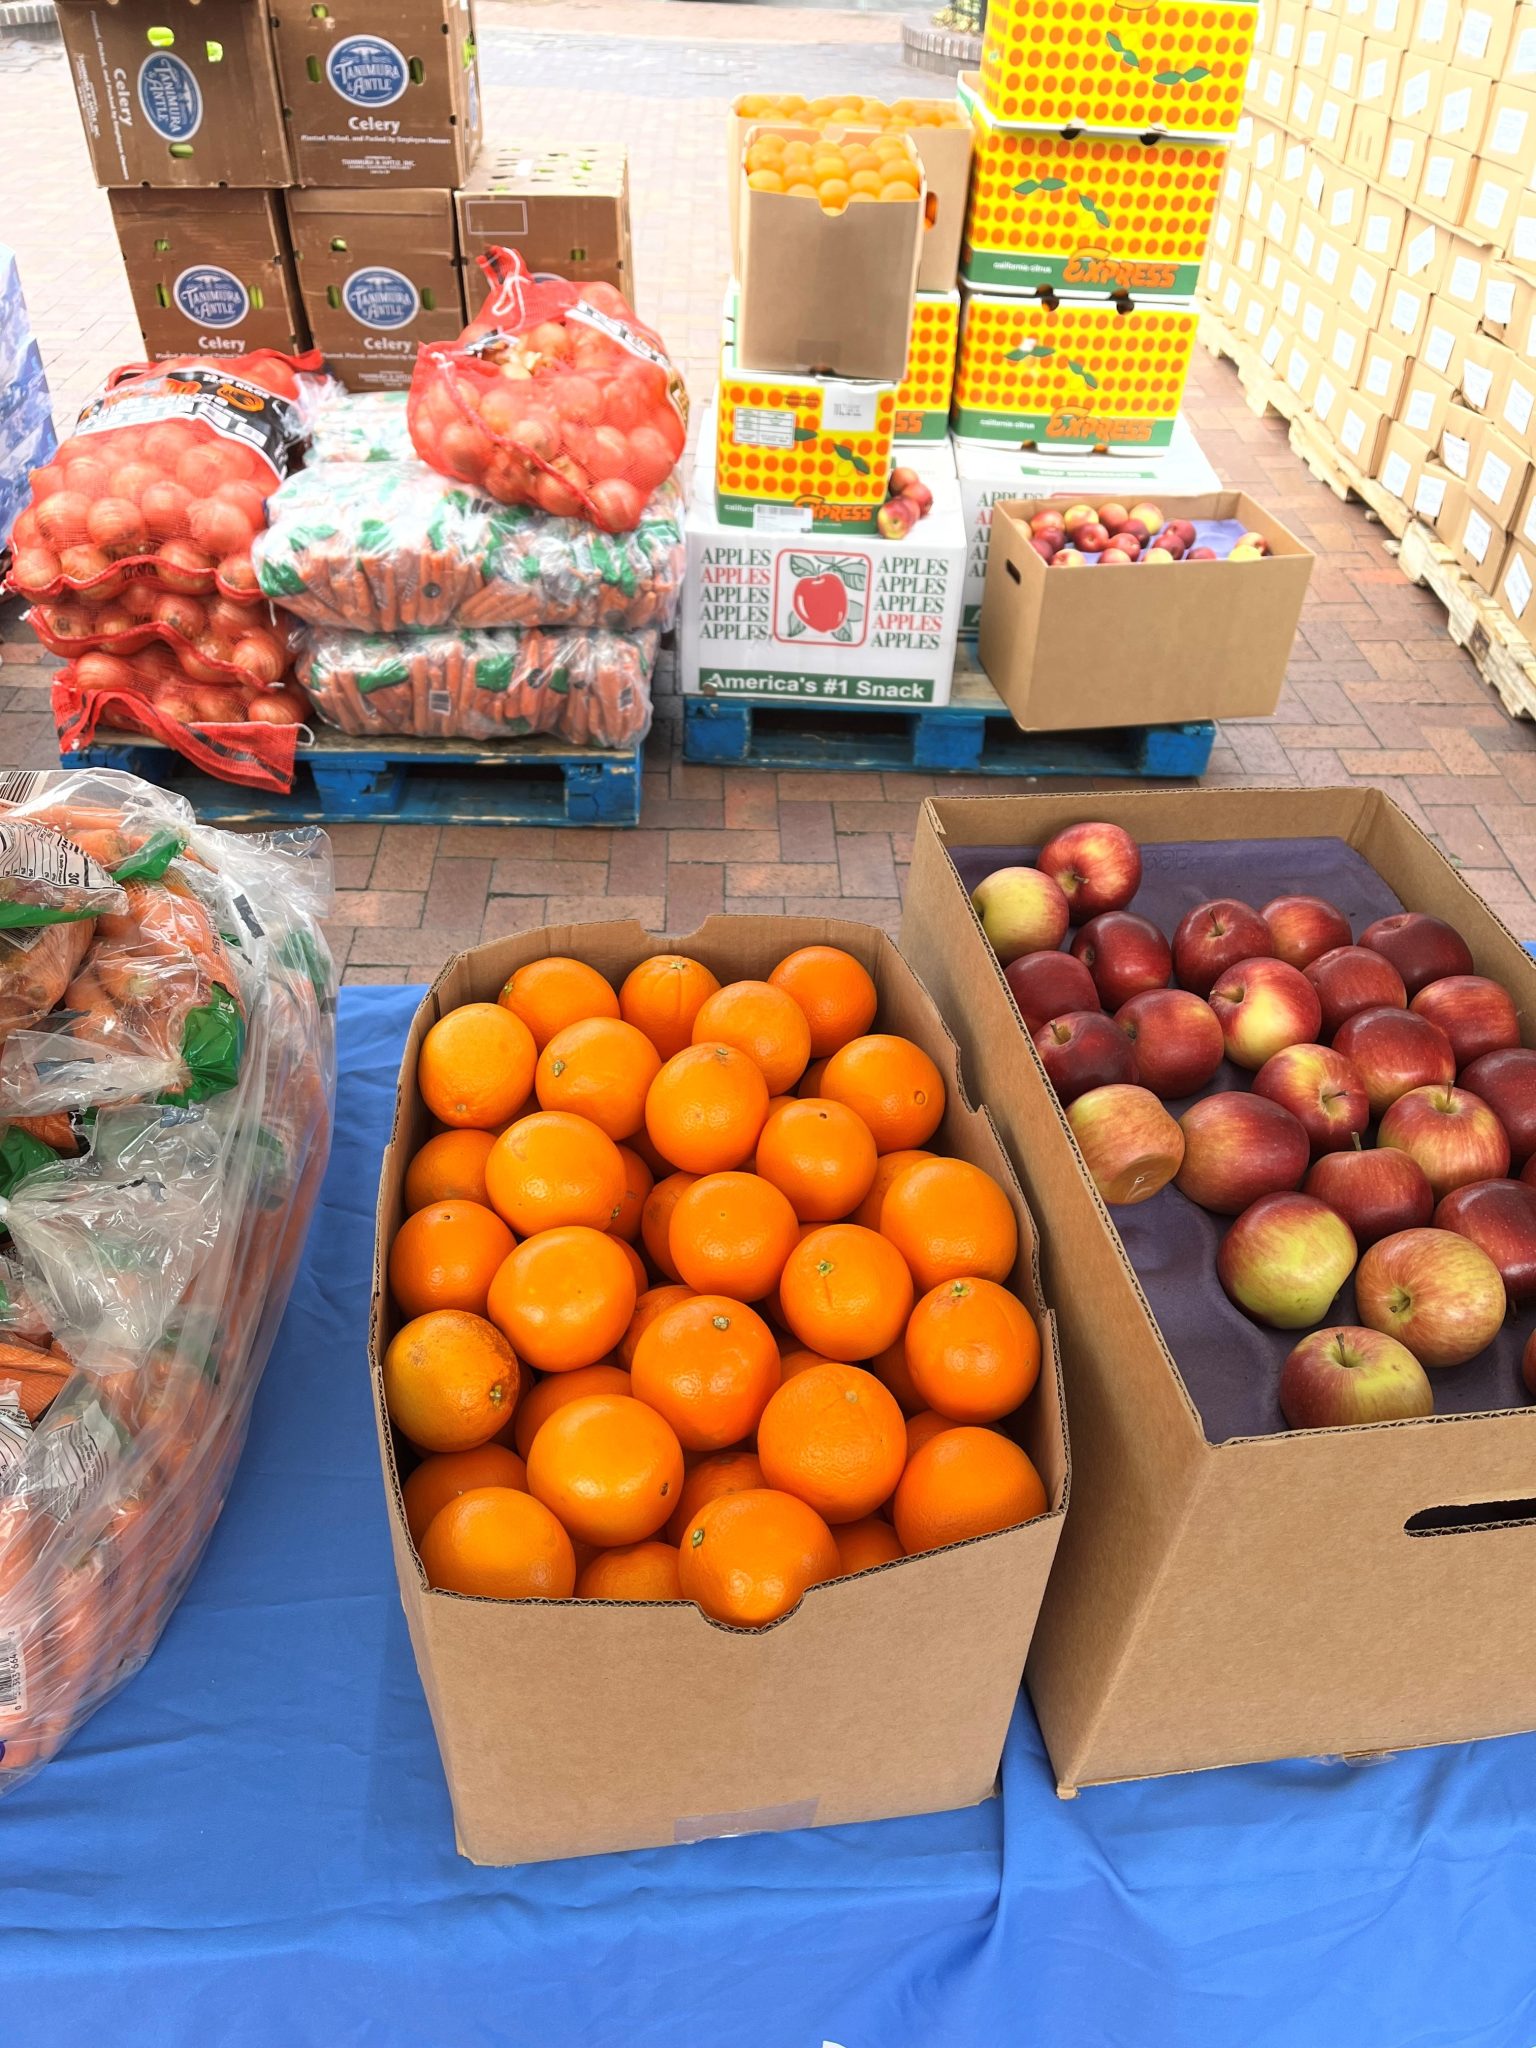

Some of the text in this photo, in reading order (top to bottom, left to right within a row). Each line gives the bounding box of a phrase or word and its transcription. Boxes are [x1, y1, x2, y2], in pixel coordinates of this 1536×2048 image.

[334, 61, 401, 84] TANIMURA
[153, 58, 182, 133] TANIMURA
[350, 76, 393, 97] ANTLE
[113, 68, 133, 126] Celery
[146, 76, 169, 122] ANTLE
[348, 116, 400, 134] Celery
[1062, 247, 1180, 289] EXPRESS
[180, 287, 242, 308] TANIMURA
[349, 289, 412, 310] TANIMURA
[199, 302, 236, 319] ANTLE
[366, 303, 404, 320] ANTLE
[198, 336, 246, 352] Celery
[363, 337, 412, 353] Celery
[1046, 405, 1157, 442] EXPRESS
[700, 547, 771, 566] APPLES
[877, 556, 949, 576] APPLES
[700, 566, 771, 585] APPLES
[700, 585, 770, 604] APPLES
[875, 576, 947, 595] APPLES
[699, 604, 769, 622] APPLES
[874, 595, 945, 613] APPLES
[699, 623, 769, 640] APPLES
[872, 613, 943, 632] APPLES
[870, 632, 941, 650] APPLES
[703, 672, 925, 699] America's #1 Snack
